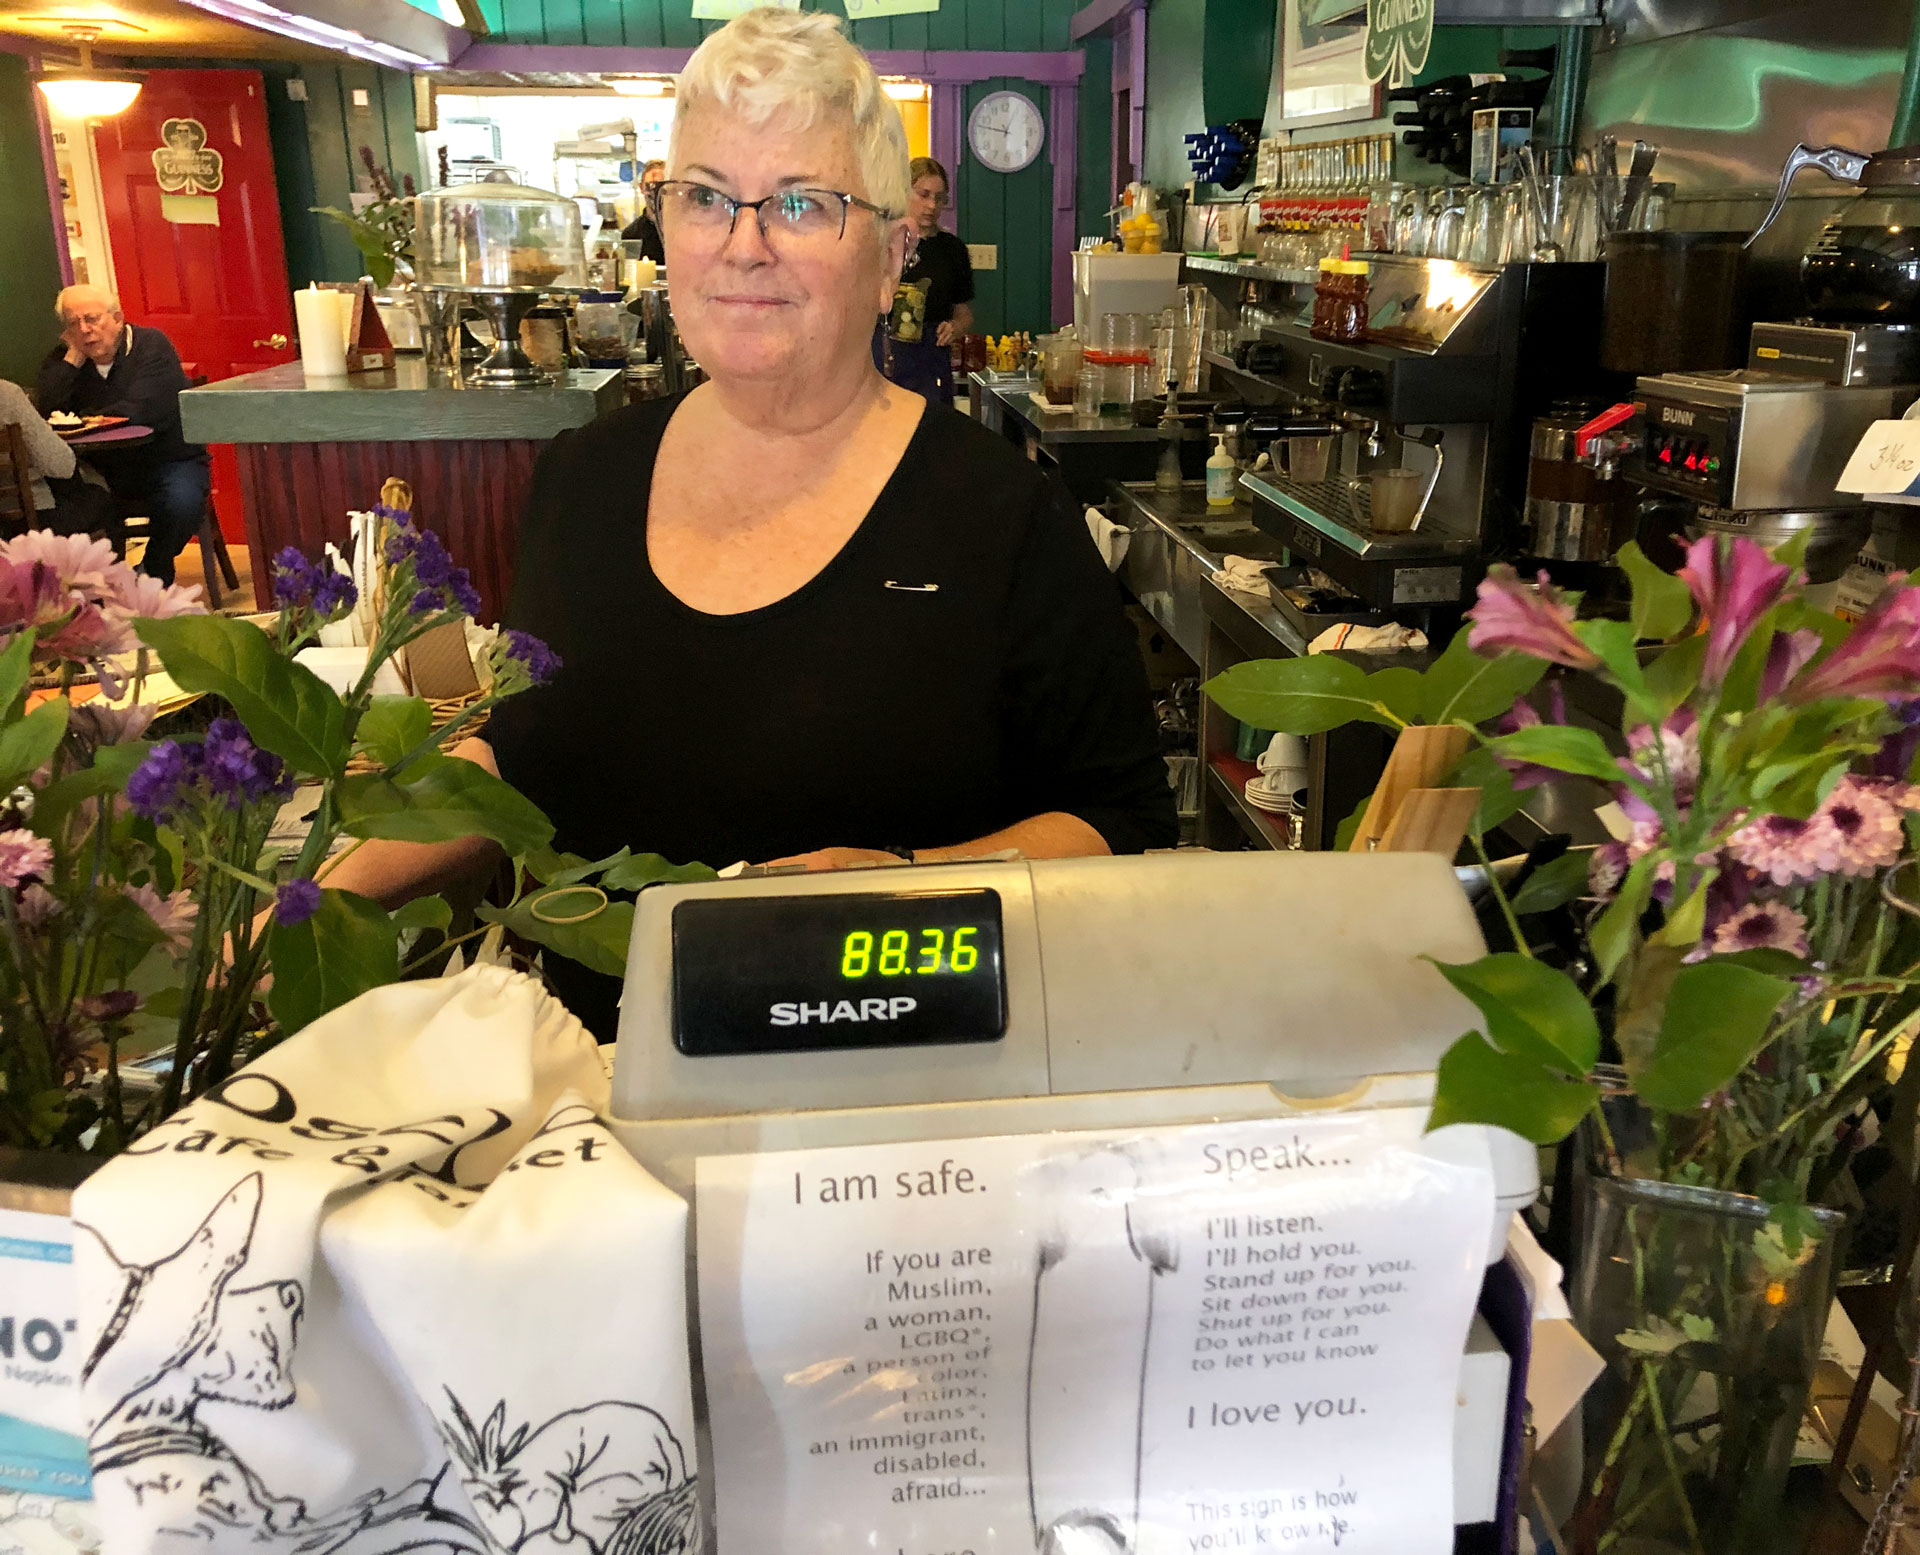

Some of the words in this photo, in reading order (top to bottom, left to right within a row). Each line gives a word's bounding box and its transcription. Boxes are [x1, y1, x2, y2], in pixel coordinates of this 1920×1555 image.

[1662, 406, 1694, 426] BUNN
[841, 927, 978, 977] 88.36
[769, 996, 918, 1026] SHARP
[1203, 1135, 1352, 1182] Speak...
[795, 1172, 802, 1204] I
[819, 1173, 878, 1203] am
[896, 1159, 987, 1198] safe.
[1206, 1216, 1237, 1239] I'll
[1247, 1215, 1324, 1237] listen.
[866, 1250, 884, 1274] If
[892, 1252, 940, 1277] you
[951, 1247, 992, 1266] are
[1206, 1247, 1237, 1267] I'll
[1246, 1242, 1301, 1264] hold
[1310, 1242, 1362, 1261] you.
[888, 1277, 992, 1302] Muslim,
[1203, 1269, 1275, 1292] Stand
[1284, 1268, 1315, 1287] up
[1323, 1262, 1358, 1280] for
[1367, 1258, 1417, 1277] you.
[1201, 1296, 1231, 1315] Sit
[1241, 1291, 1307, 1311] down
[1316, 1285, 1350, 1301] for
[1358, 1280, 1409, 1299] you.
[864, 1317, 878, 1331] a
[1199, 1314, 1252, 1333] Shut
[1262, 1311, 1292, 1328] up
[1302, 1306, 1336, 1323] for
[1343, 1301, 1392, 1319] you.
[1194, 1336, 1228, 1353] Do
[1236, 1329, 1295, 1349] what
[1303, 1327, 1312, 1341] I
[1318, 1323, 1360, 1339] can
[842, 1362, 856, 1375] a
[867, 1352, 955, 1375] person
[965, 1345, 993, 1361] of
[1191, 1357, 1216, 1371] to
[1225, 1353, 1254, 1370] let
[1262, 1350, 1306, 1368] you
[1315, 1343, 1379, 1361] know
[1188, 1405, 1195, 1429] I
[1211, 1402, 1281, 1427] love
[1294, 1397, 1367, 1425] you.
[809, 1439, 839, 1455] an
[849, 1425, 986, 1451] immigrant,
[873, 1448, 986, 1475] disabled,
[1186, 1502, 1231, 1522] This
[1240, 1497, 1283, 1519] sign
[1292, 1495, 1307, 1511] is
[1315, 1490, 1358, 1509] how
[1255, 1522, 1311, 1544] kow
